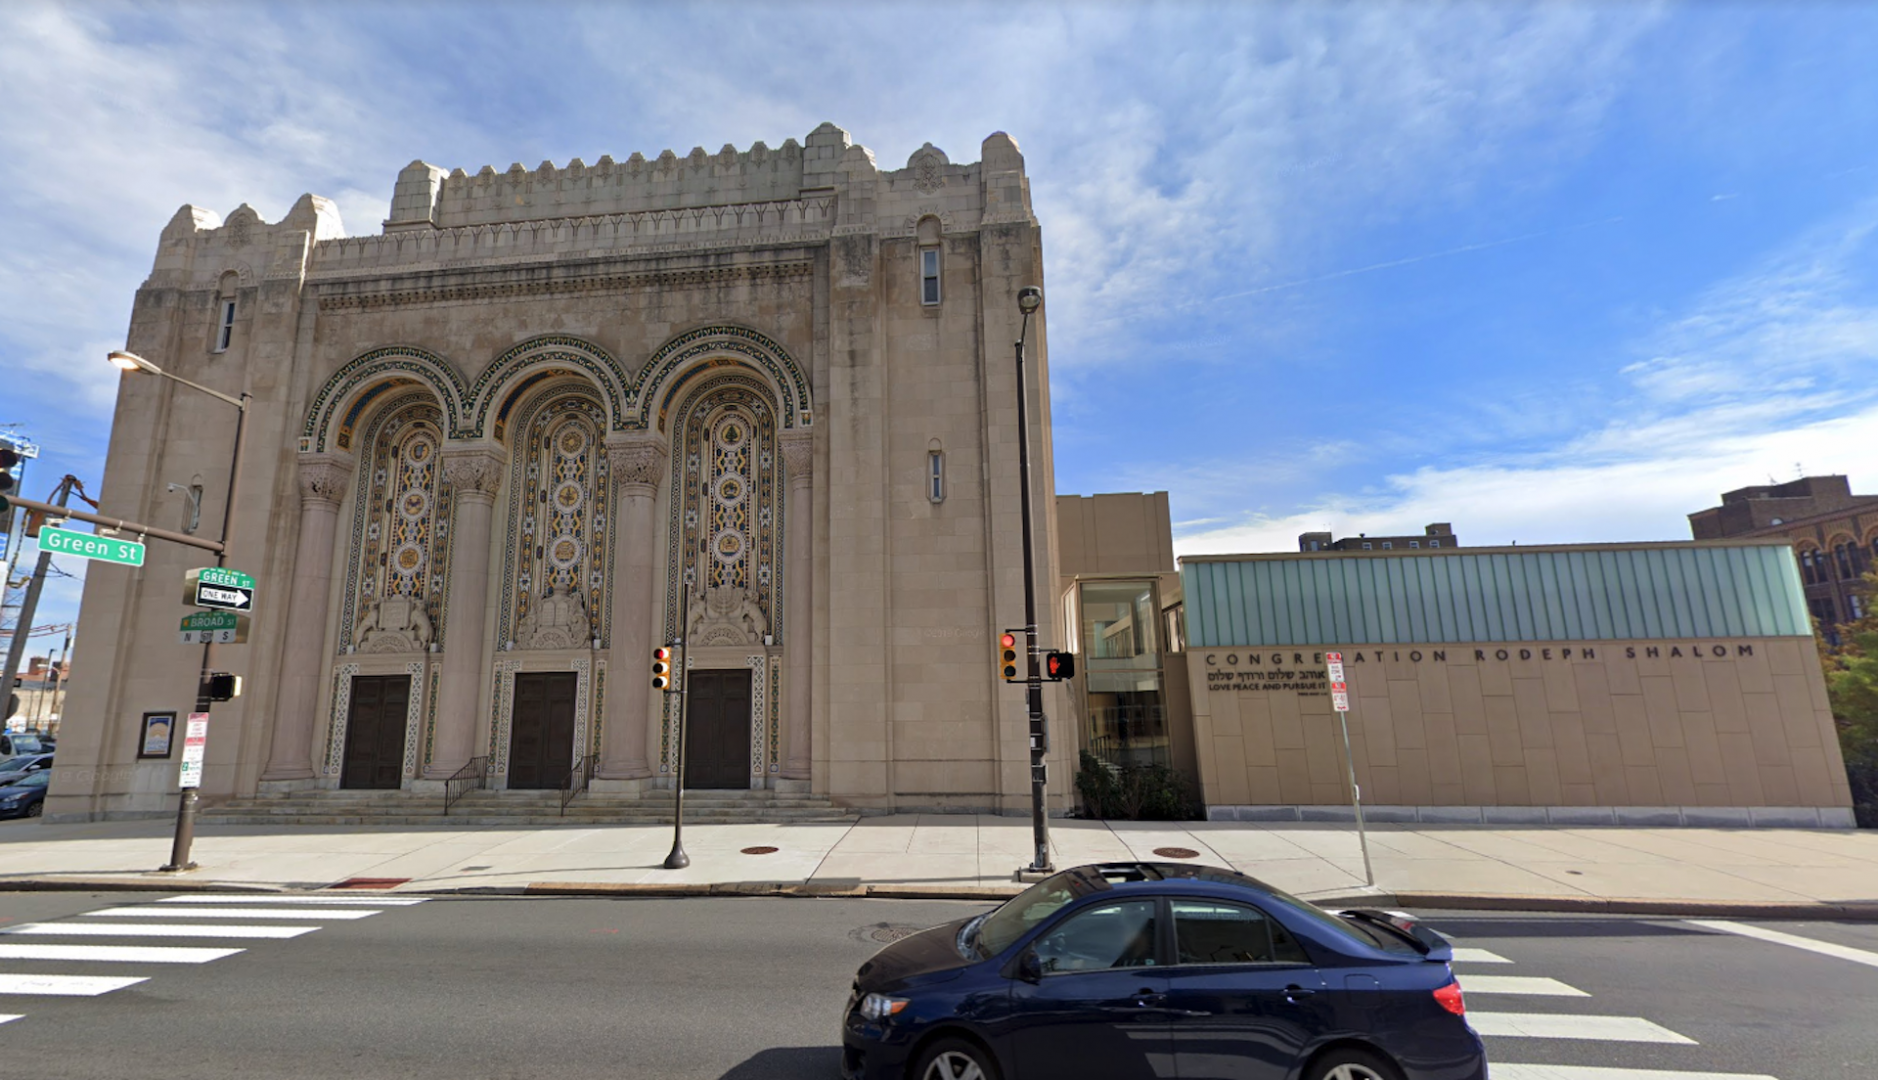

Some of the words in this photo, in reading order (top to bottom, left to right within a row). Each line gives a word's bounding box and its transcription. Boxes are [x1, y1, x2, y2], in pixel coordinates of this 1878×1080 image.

[48, 532, 108, 556] Green
[117, 545, 136, 560] St
[203, 571, 238, 585] GREEN
[203, 590, 219, 599] ONE
[191, 617, 224, 627] BROAD
[184, 632, 191, 642] N
[222, 631, 229, 640] S
[1206, 650, 1446, 666] CONGREATION
[1475, 648, 1595, 662] RODEPH
[1626, 645, 1753, 660] SHALOM
[1207, 669, 1234, 681] שלום
[1267, 668, 1294, 680] שלום
[1209, 683, 1231, 691] LOVE
[1233, 683, 1260, 691] PEACE
[1262, 682, 1281, 690] AND
[1283, 682, 1317, 690] PURSUE
